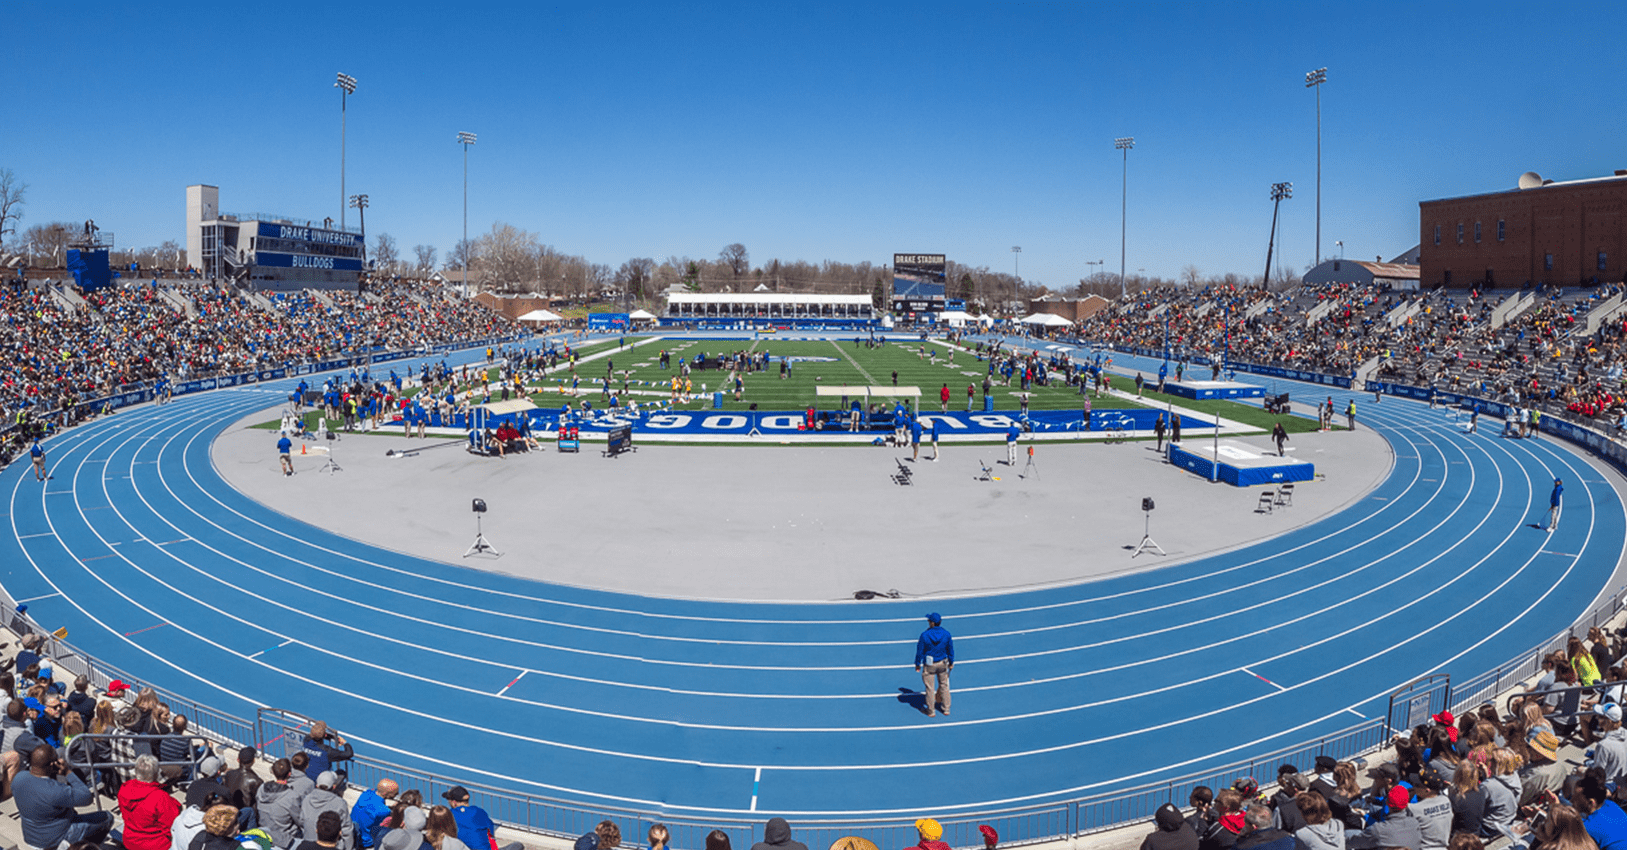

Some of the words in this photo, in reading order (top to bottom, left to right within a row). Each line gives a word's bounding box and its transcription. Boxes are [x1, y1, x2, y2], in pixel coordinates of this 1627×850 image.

[280, 225, 308, 241] DRAKE
[311, 231, 355, 246] UNIVERSITY
[292, 255, 334, 269] BULLDOGS
[895, 255, 916, 264] DRAKE
[917, 255, 944, 264] STADIUM
